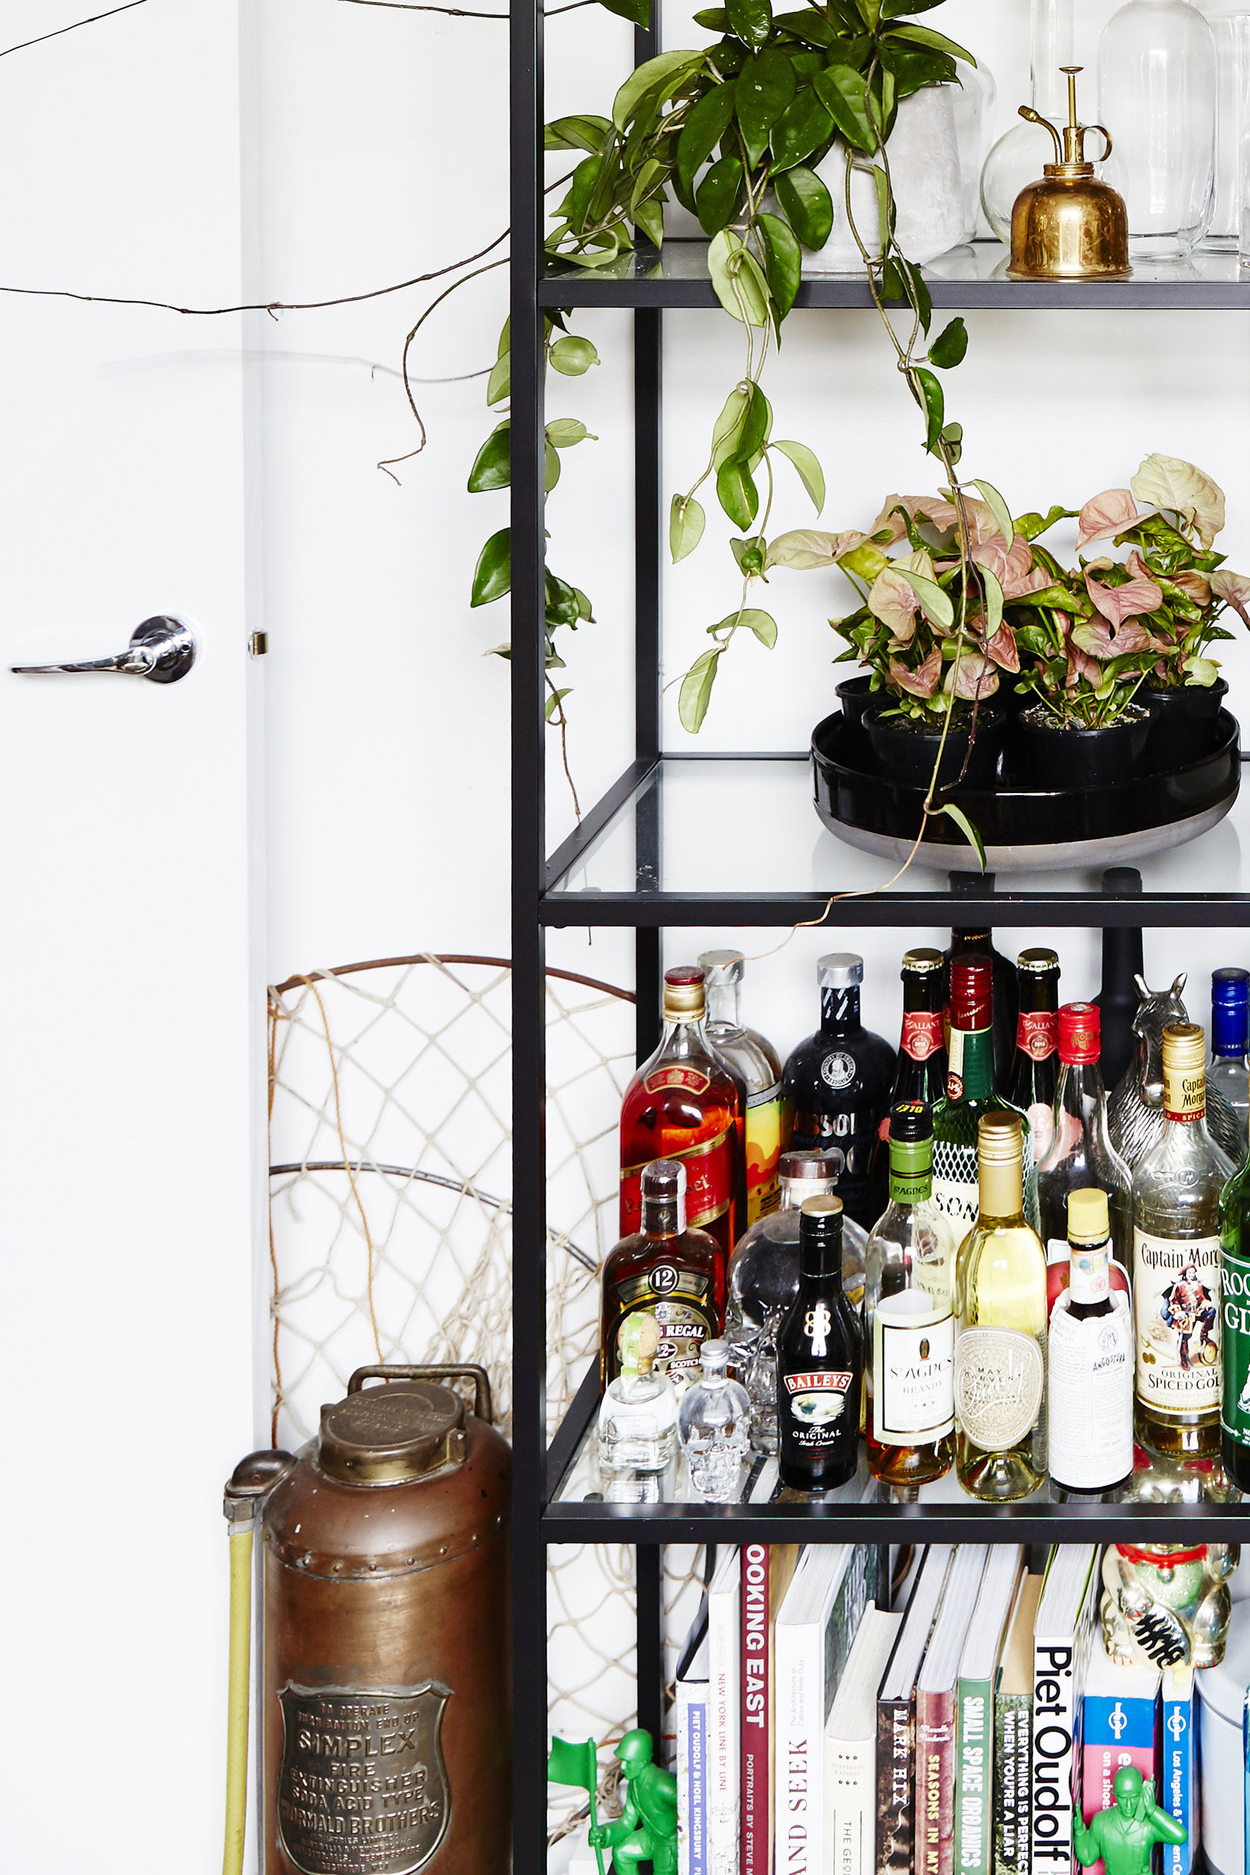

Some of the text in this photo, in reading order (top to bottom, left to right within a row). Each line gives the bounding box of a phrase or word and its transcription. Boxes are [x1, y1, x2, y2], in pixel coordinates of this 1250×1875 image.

[1141, 1242, 1219, 1269] Captain Morg
[655, 1270, 673, 1287] 12
[666, 1325, 704, 1338] REGAL
[787, 1374, 850, 1390] BAILEYS
[1149, 1373, 1219, 1391] SPICED GOL
[1161, 1368, 1217, 1379] ORIGINAL
[903, 1381, 942, 1395] BRANDY
[793, 1430, 842, 1440] ORIGINAL
[746, 1544, 765, 1728] OOKING EAST
[718, 1673, 726, 1697] NEW
[692, 1711, 701, 1731] PIET
[718, 1700, 726, 1727] YORK
[298, 1727, 416, 1759] SIMPLEX
[692, 1733, 701, 1769] OUDOLF
[719, 1731, 727, 1752] LINE
[1017, 1710, 1029, 1798] EVERYTHING
[1034, 1646, 1073, 1861] Piet Oudolf
[330, 1761, 376, 1777] FIRE
[719, 1755, 727, 1768] BY
[892, 1708, 908, 1806] MARK HIX
[1102, 1751, 1111, 1767] on
[290, 1767, 427, 1794] EXTINGUISHER
[693, 1770, 701, 1779] &
[719, 1771, 727, 1791] LINE
[788, 1739, 808, 1812] SEEK
[961, 1696, 985, 1868] SMALL SPACE ORGANICS
[1003, 1711, 1016, 1857] WHEN YOU'RE A LIAR
[1170, 1750, 1183, 1817] Los Angeles &
[292, 1785, 424, 1811] SODA ACID TYPE
[693, 1780, 702, 1806] NOEL
[927, 1755, 940, 1821] SEASONS
[351, 1800, 441, 1835] BROTHERS
[746, 1754, 754, 1865] PORTRAITS BY STEVE
[1017, 1800, 1029, 1814] IS
[693, 1807, 702, 1860] KINGSBURY
[843, 1822, 852, 1844] THE
[927, 1827, 939, 1844] IN
[926, 1851, 939, 1875] MY
